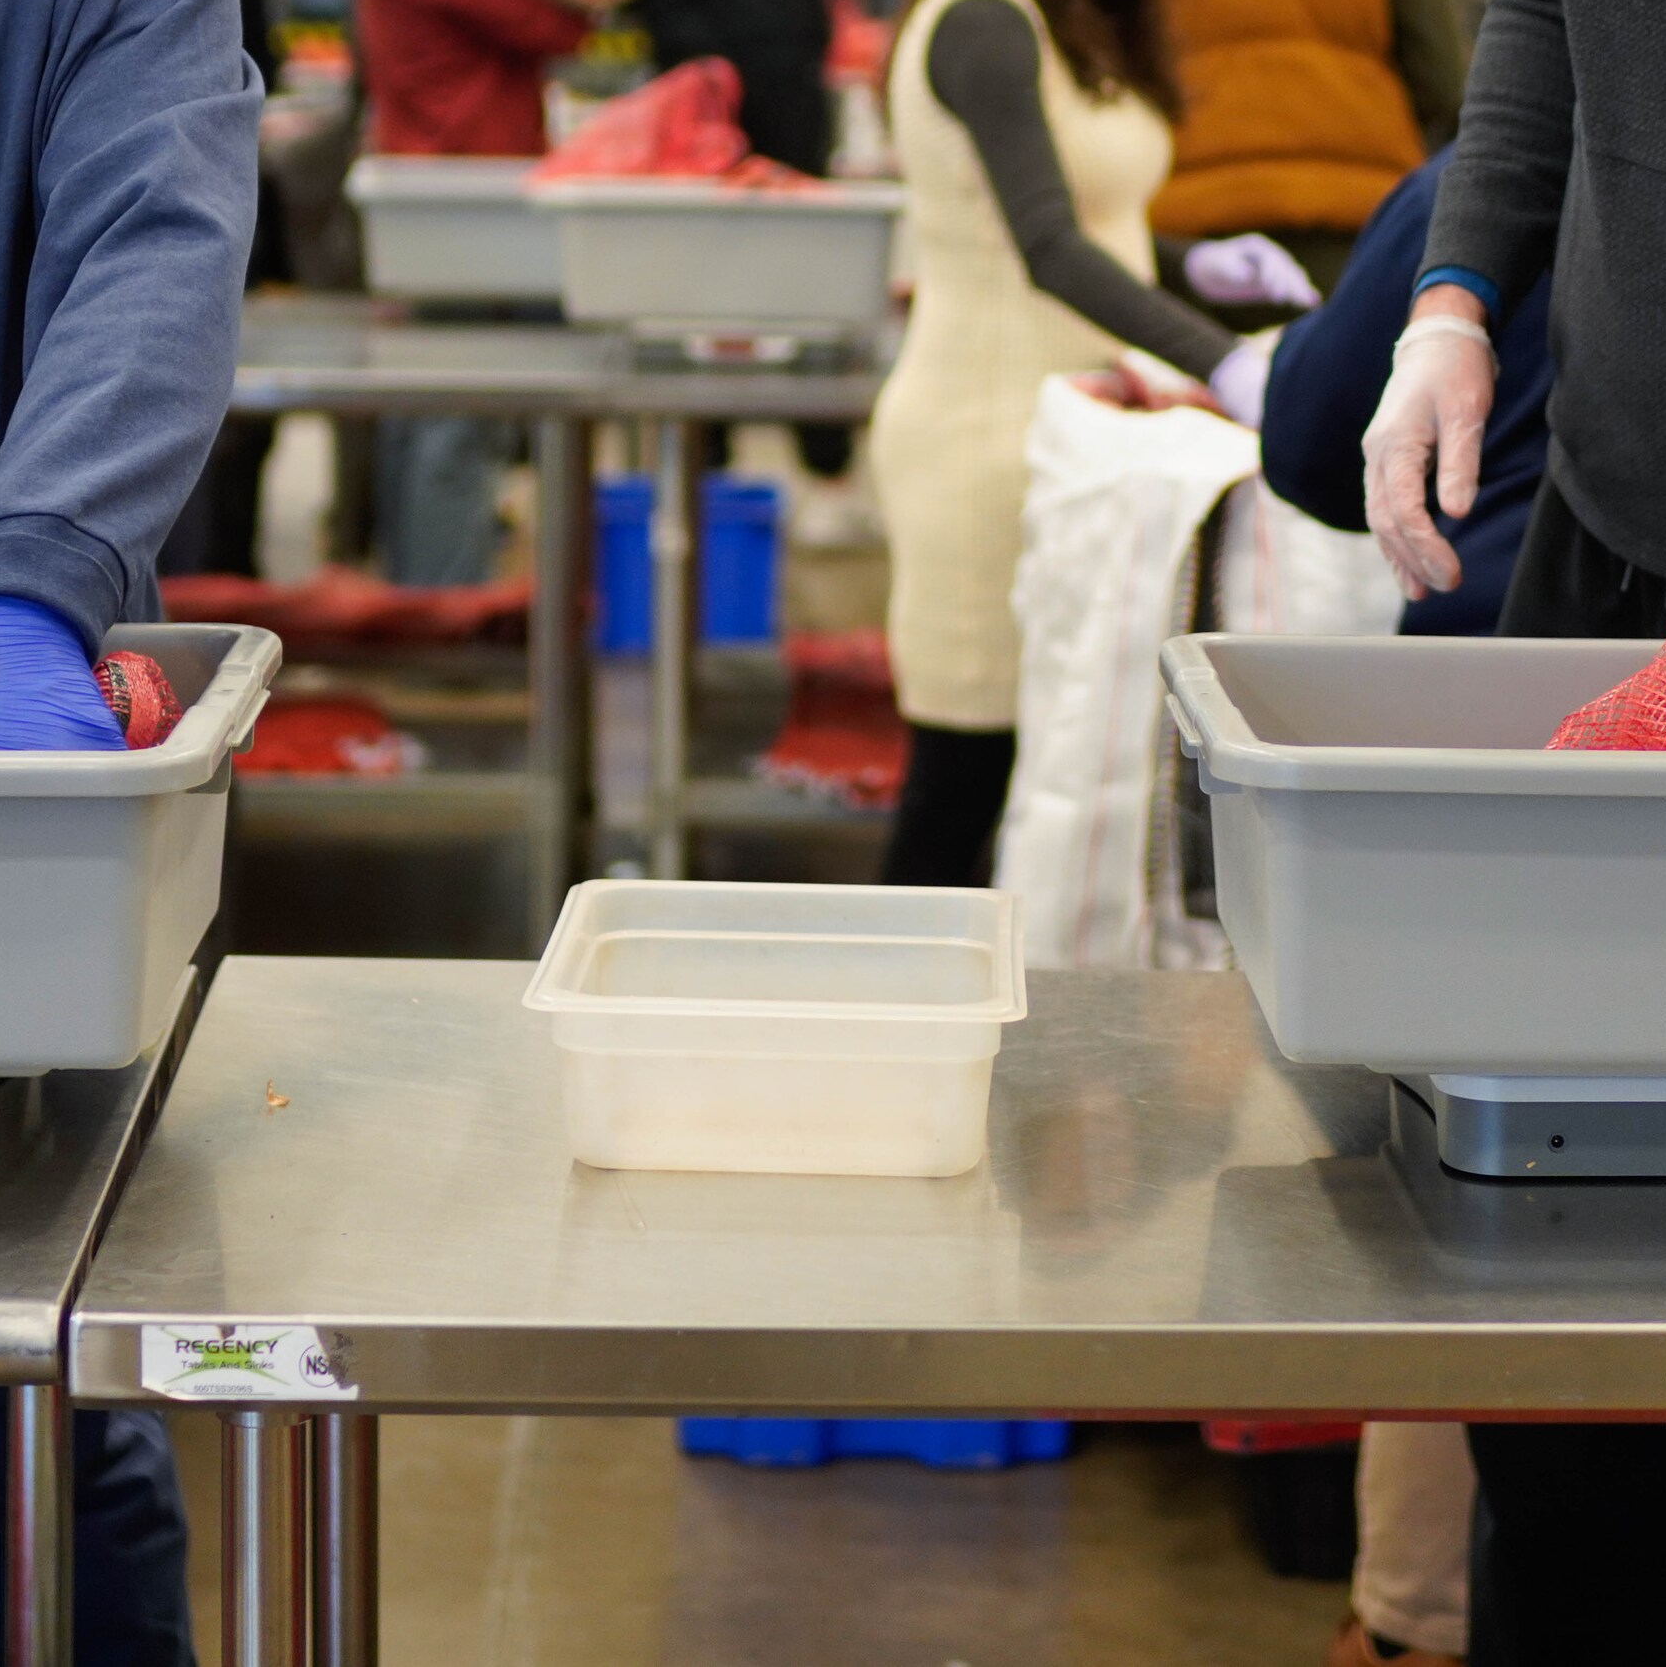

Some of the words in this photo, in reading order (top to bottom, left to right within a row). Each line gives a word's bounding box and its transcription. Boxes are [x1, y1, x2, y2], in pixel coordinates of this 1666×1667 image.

[175, 1339, 278, 1354] REGENCY
[181, 1360, 215, 1370] Tables
[219, 1360, 241, 1370] And
[244, 1360, 275, 1370] Sinks
[306, 1355, 334, 1376] NS
